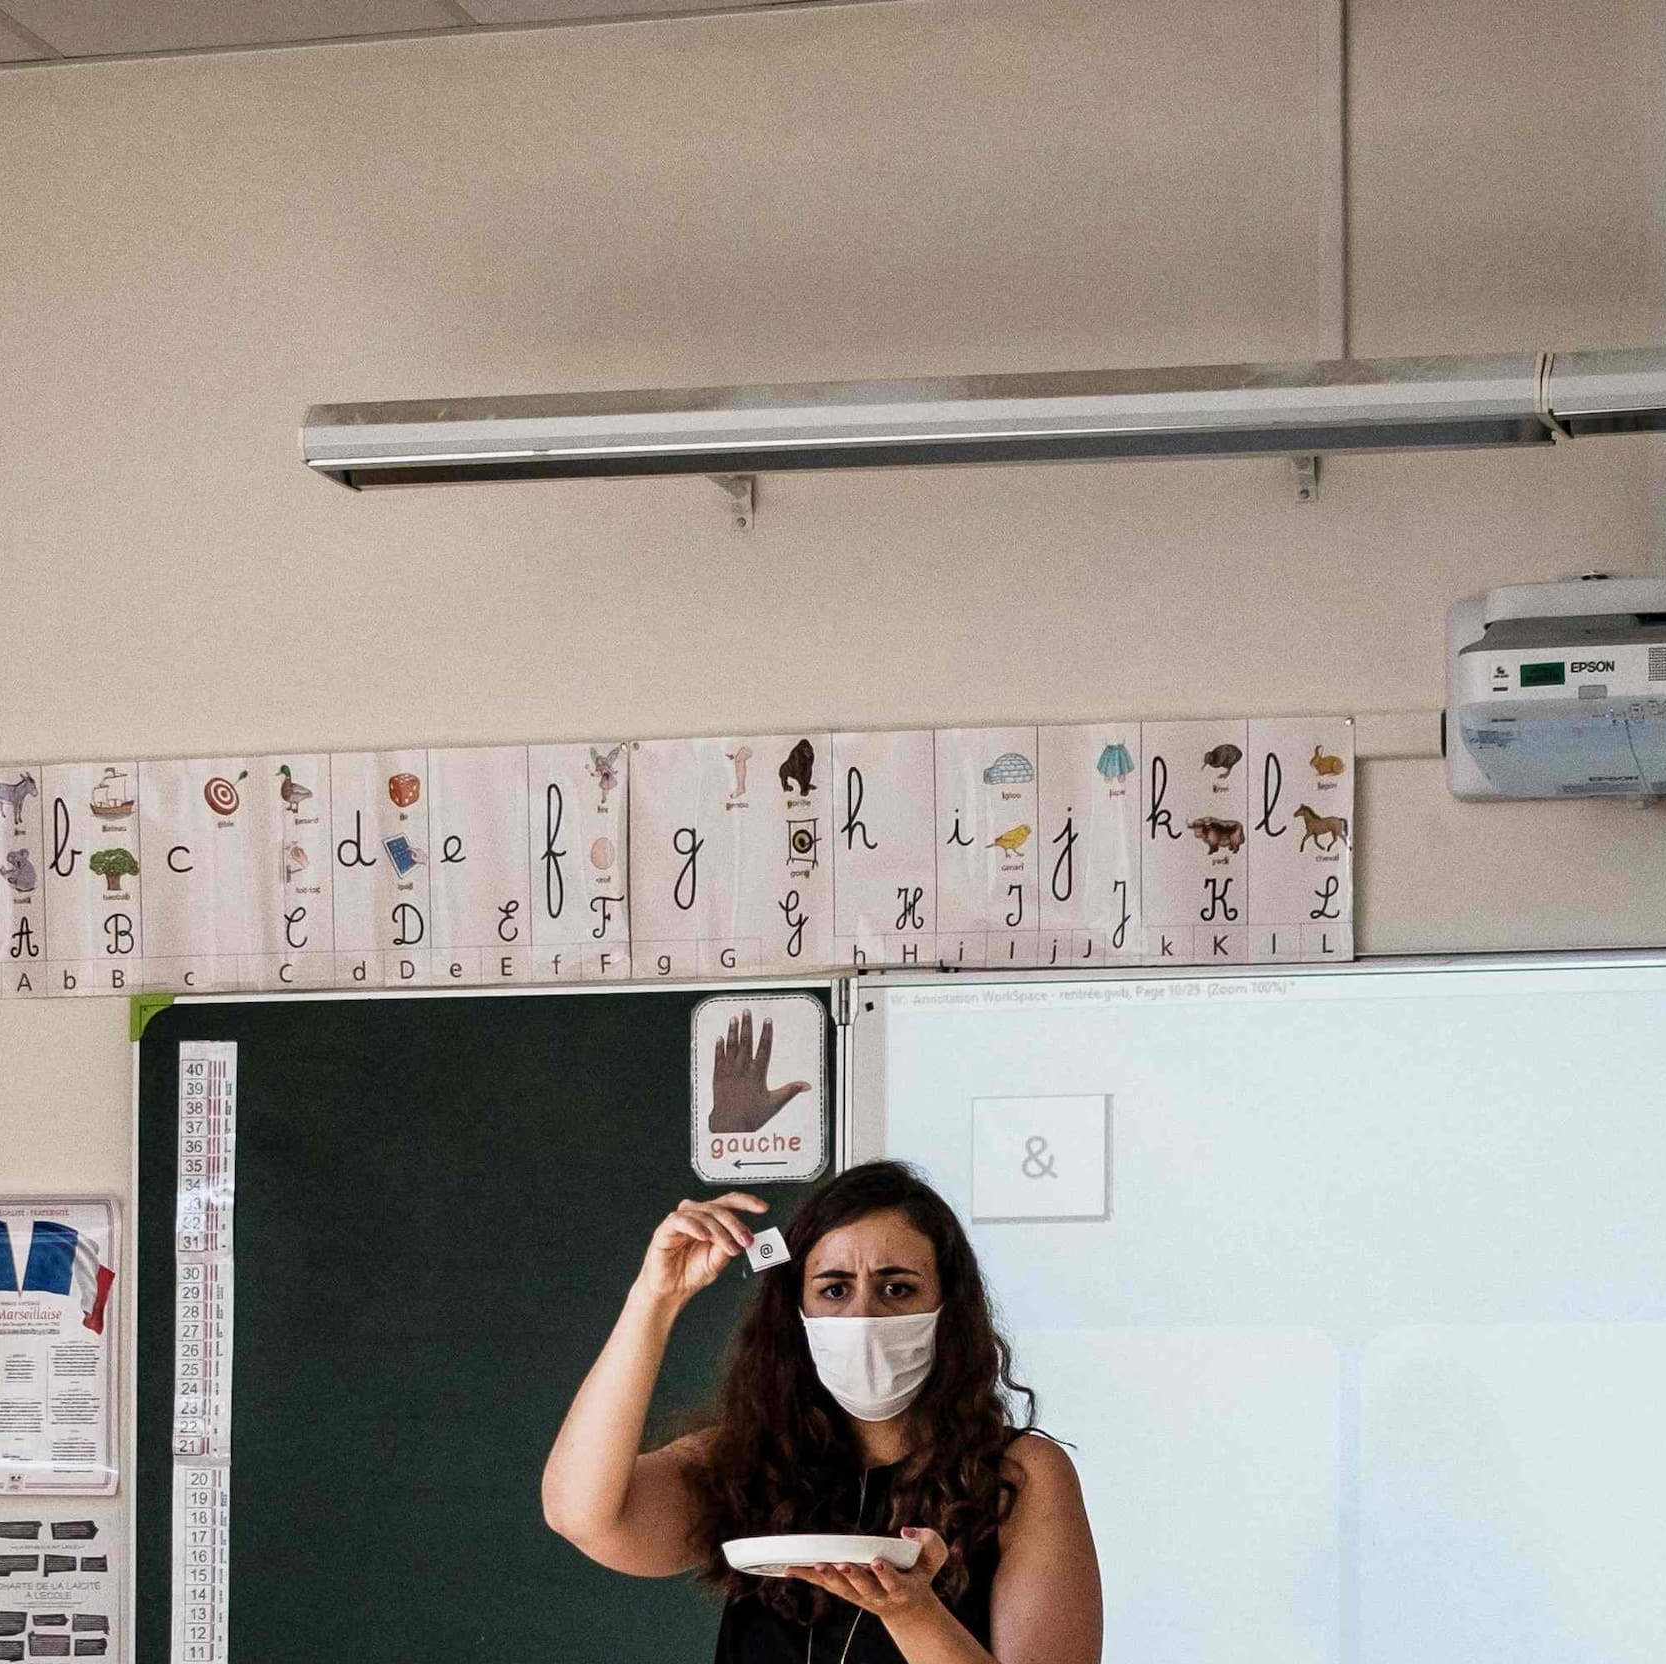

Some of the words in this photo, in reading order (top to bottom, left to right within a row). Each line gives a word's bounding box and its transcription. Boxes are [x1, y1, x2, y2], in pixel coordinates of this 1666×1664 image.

[1571, 661, 1614, 673] EPSON
[48, 797, 83, 878] b
[166, 845, 194, 874] c
[337, 810, 377, 868] d
[440, 834, 467, 864] e
[540, 783, 567, 919] f
[673, 827, 705, 911] g
[840, 766, 878, 850] h
[946, 808, 974, 847] i
[1051, 806, 1079, 902] j
[1146, 755, 1183, 840] k
[1254, 752, 1287, 838] l
[16, 972, 33, 992] A
[111, 969, 125, 989] B
[278, 962, 293, 984] C
[399, 959, 416, 980] D
[500, 956, 513, 977] E
[600, 953, 612, 974] F
[719, 947, 736, 969] G
[901, 943, 919, 964] H
[1009, 940, 1015, 960] I
[1082, 939, 1092, 959] J
[1213, 935, 1229, 956] K
[1321, 933, 1334, 954] L
[186, 1063, 204, 1076] 40
[186, 1081, 204, 1096] 39
[185, 1120, 203, 1135] 37
[185, 1139, 203, 1154] 36
[711, 1134, 800, 1158] gauche
[1022, 1136, 1058, 1179] &
[185, 1158, 203, 1173] 35
[183, 1235, 199, 1250] 31
[760, 1244, 773, 1258] @
[182, 1266, 200, 1281] 30
[182, 1305, 200, 1319] 28
[190, 1472, 209, 1486] 20
